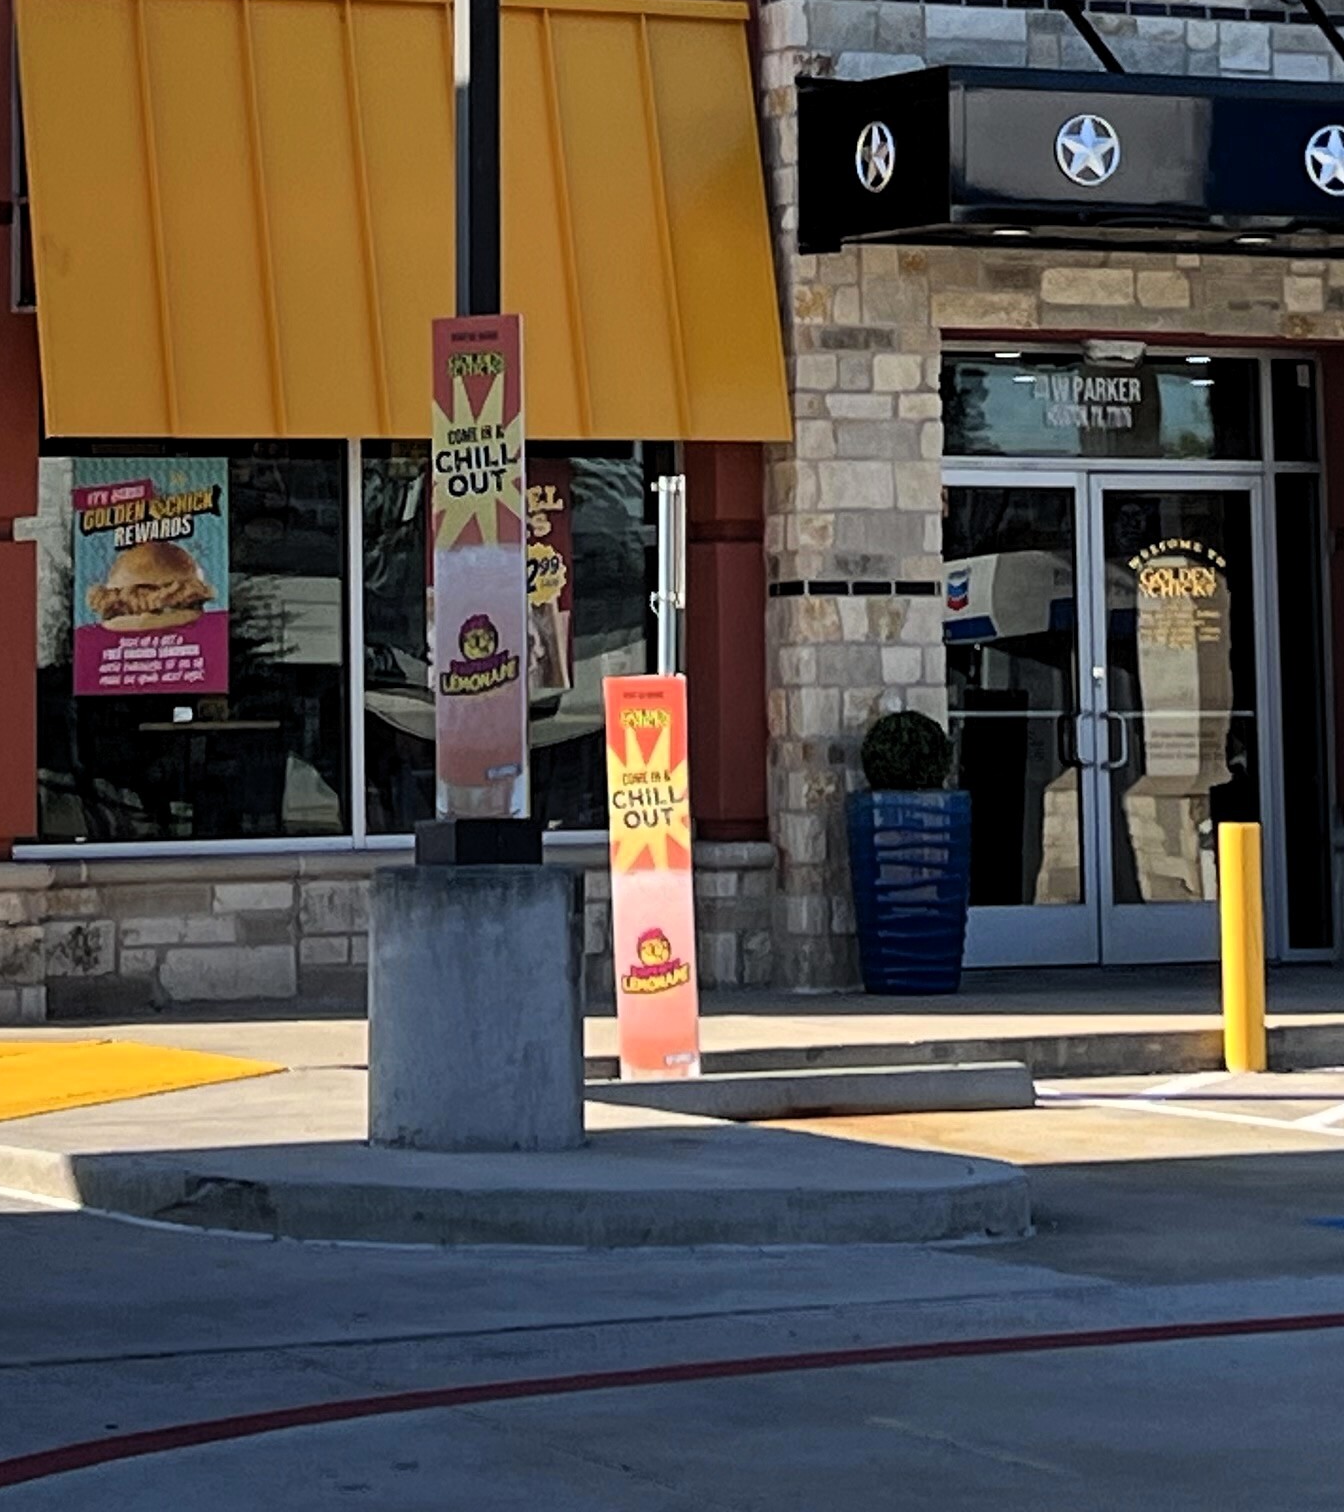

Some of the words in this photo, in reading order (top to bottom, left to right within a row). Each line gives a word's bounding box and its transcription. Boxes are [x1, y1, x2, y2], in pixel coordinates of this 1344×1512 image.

[1072, 376, 1142, 403] PARKER
[435, 442, 518, 473] CHILL
[447, 468, 507, 497] OUT
[83, 499, 146, 530] GOLDEN
[166, 489, 214, 517] CHICK
[114, 514, 192, 548] REWARDS
[1140, 567, 1216, 585] GOLDEN
[612, 785, 684, 810] CHILL
[623, 807, 674, 830] OUT
